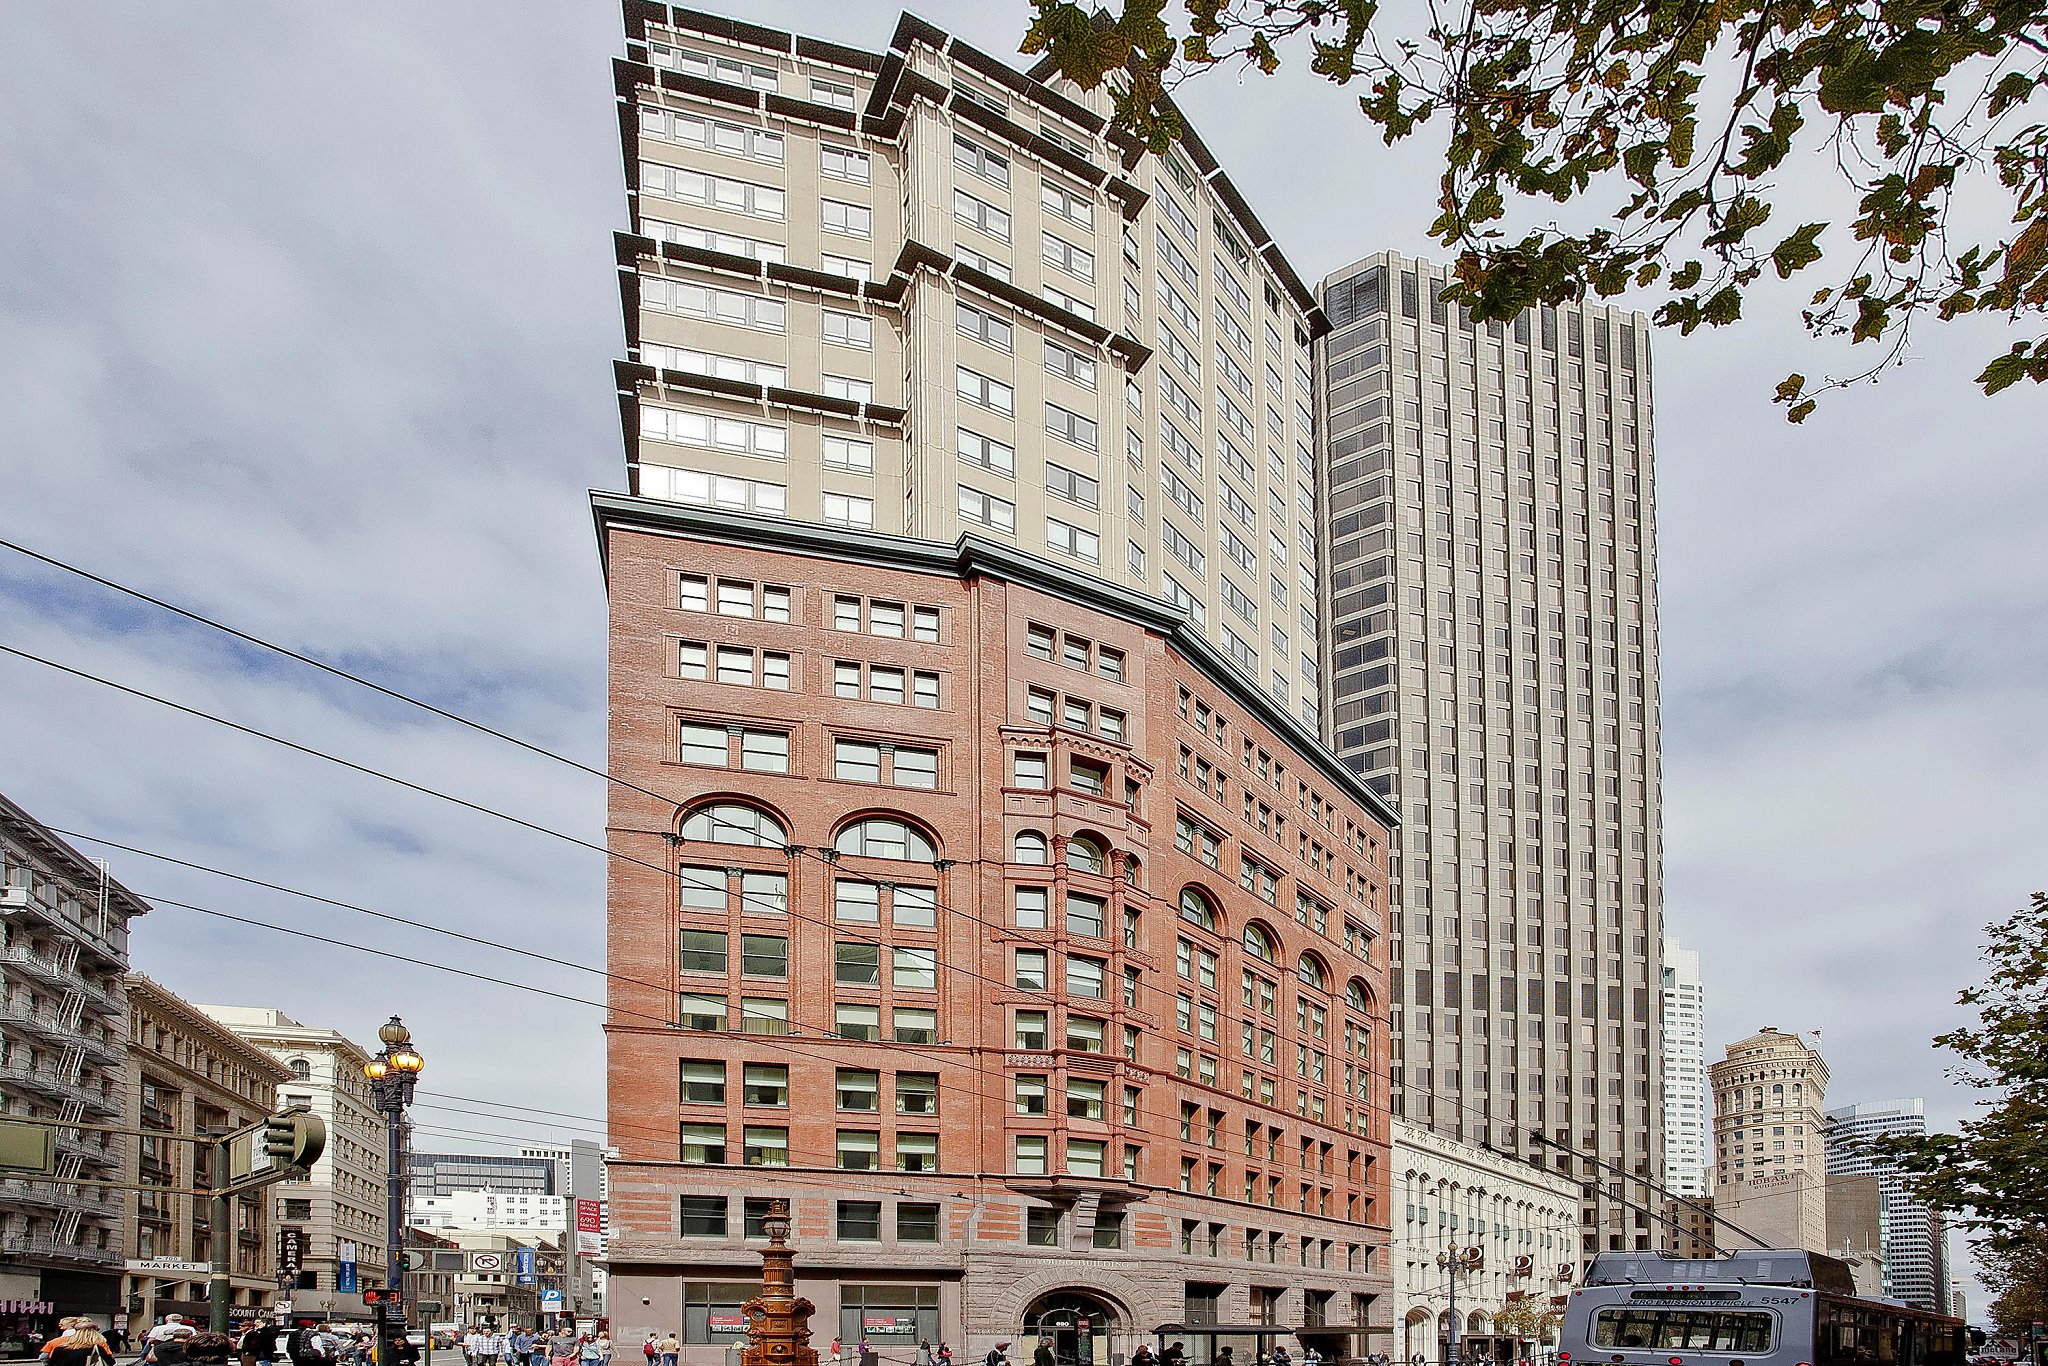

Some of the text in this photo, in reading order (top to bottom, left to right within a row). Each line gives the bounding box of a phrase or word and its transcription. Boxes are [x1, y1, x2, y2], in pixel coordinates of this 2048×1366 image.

[1748, 1173, 1797, 1186] HOBART
[1754, 1181, 1790, 1189] BUILDING
[286, 1232, 298, 1268] CAMERA
[140, 1262, 198, 1270] MARKET
[1078, 1259, 1129, 1268] BUILDING
[1760, 1297, 1800, 1305] 5547
